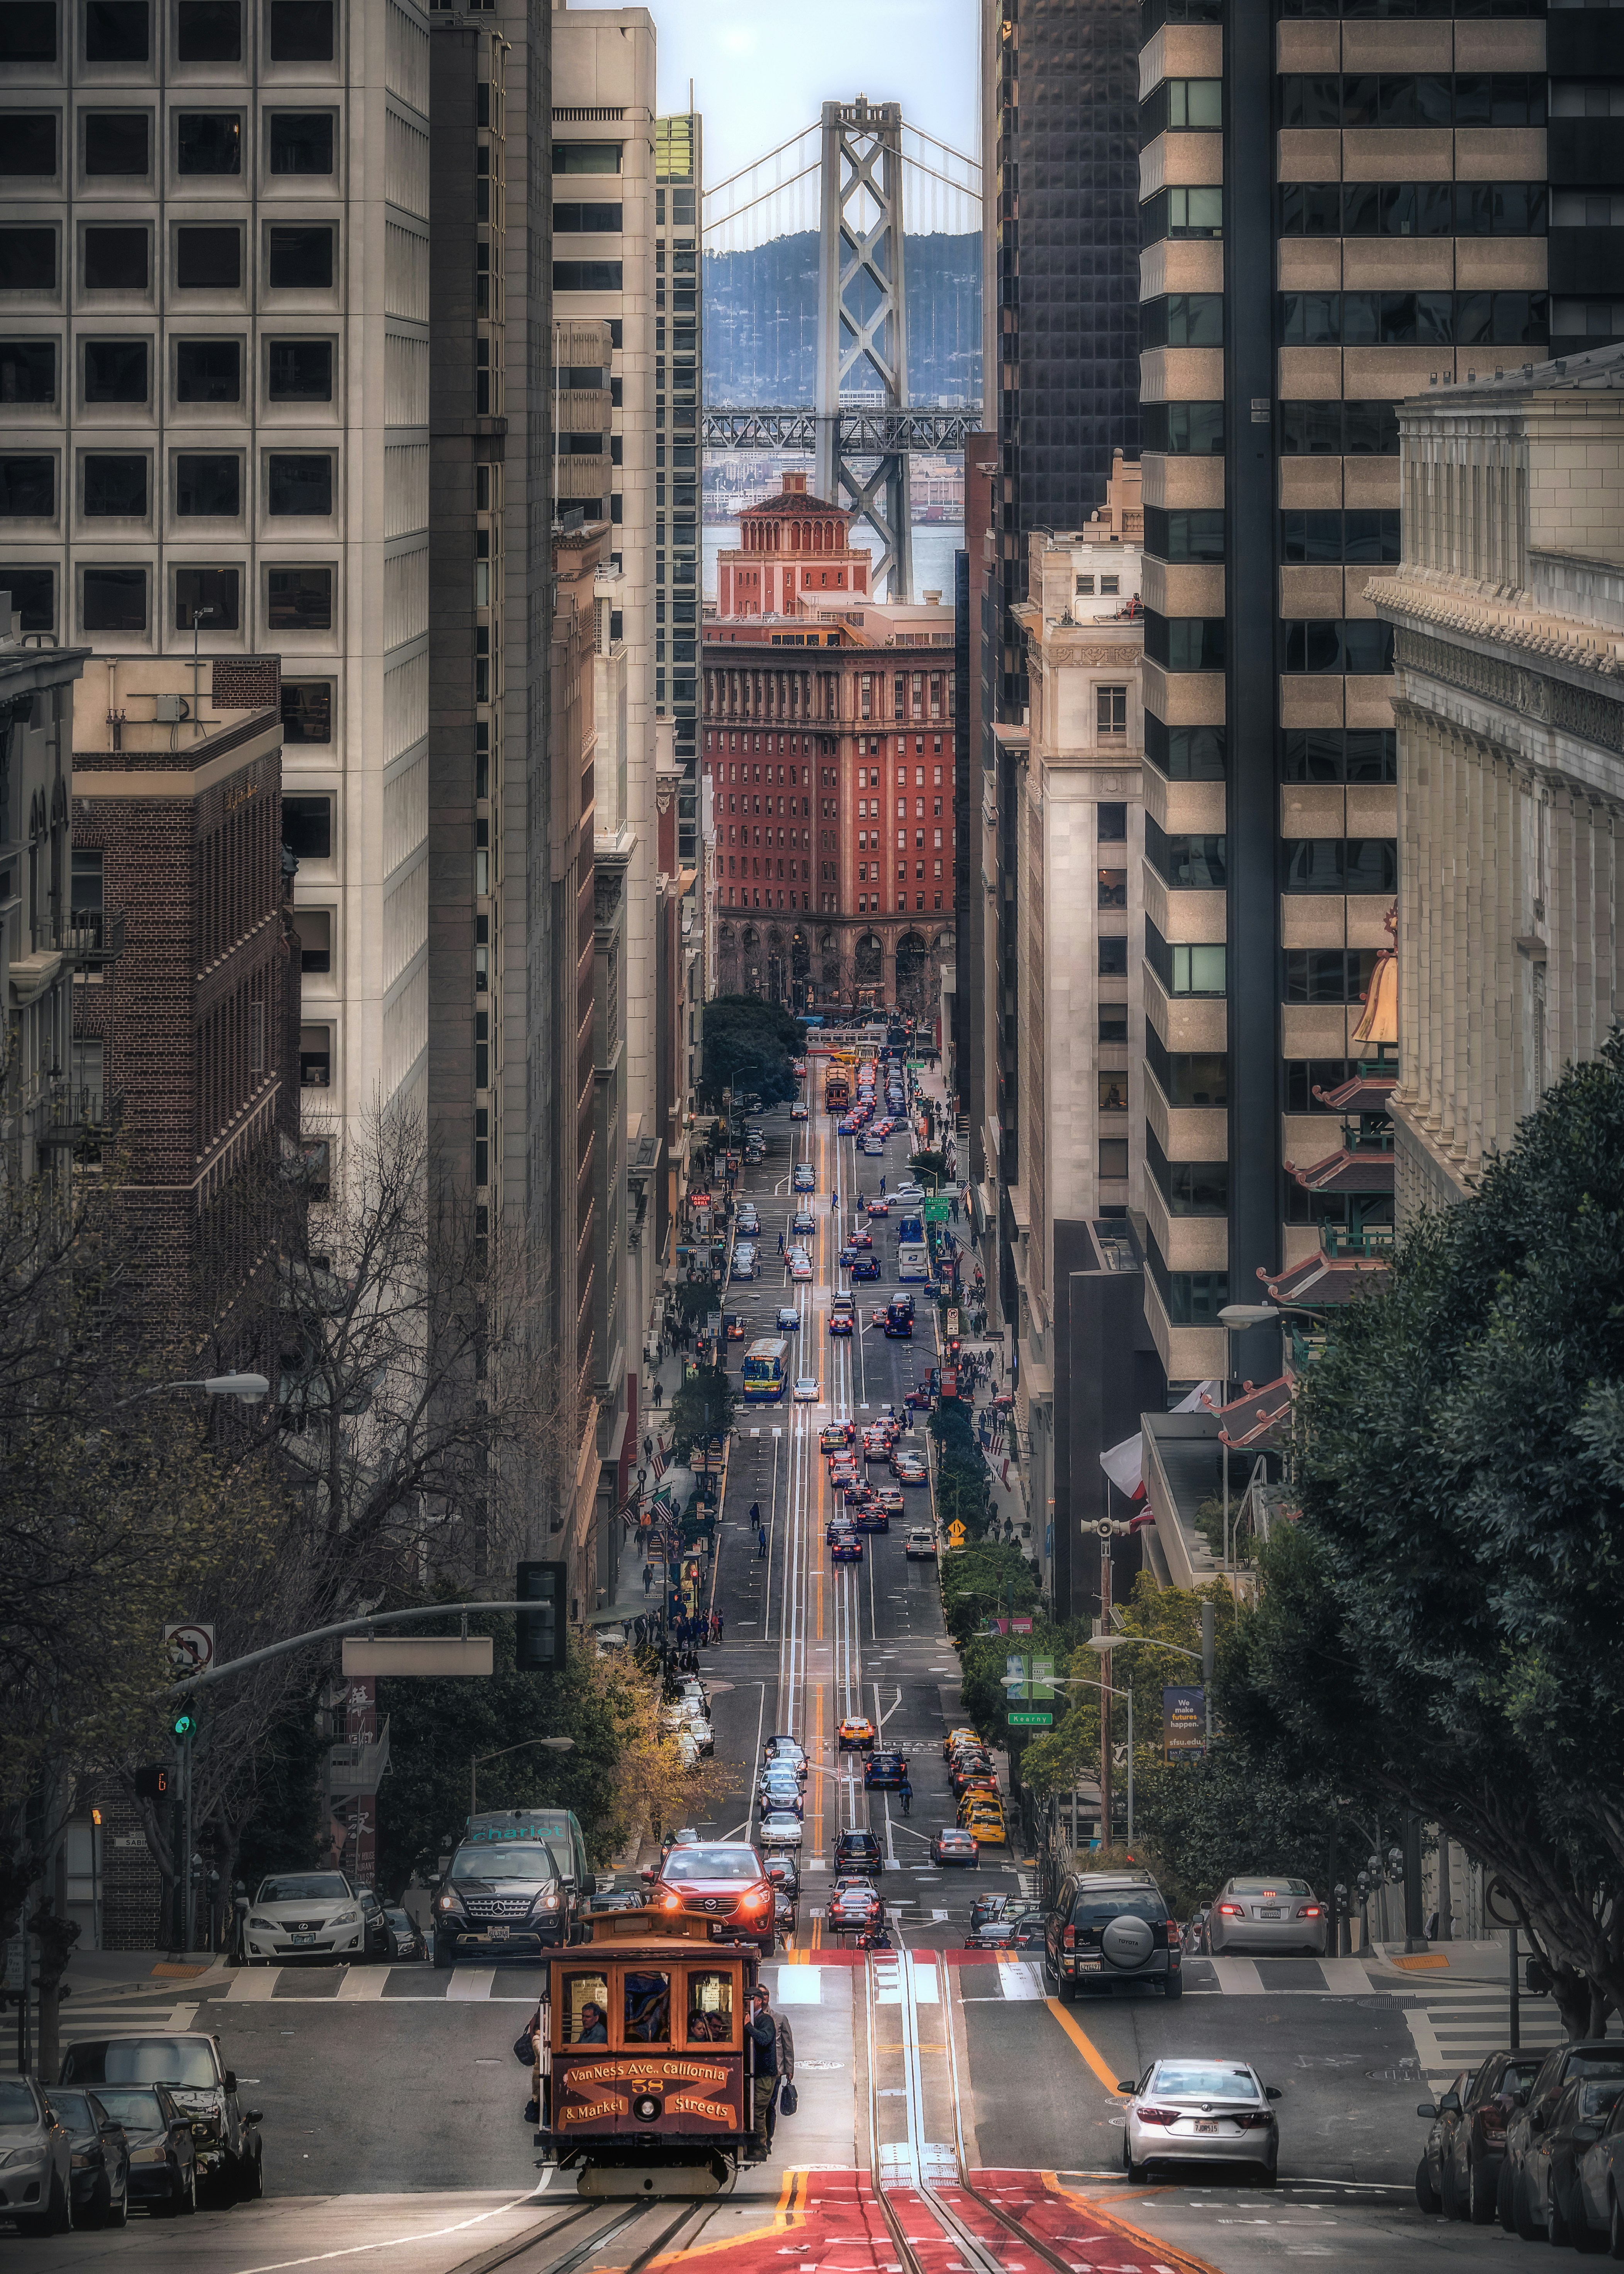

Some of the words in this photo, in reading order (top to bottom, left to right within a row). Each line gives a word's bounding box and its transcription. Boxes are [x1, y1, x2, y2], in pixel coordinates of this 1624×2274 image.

[159, 1773, 166, 1790] 6
[473, 1825, 564, 1840] chariot
[362, 1851, 375, 1860] HOUSE
[571, 2070, 592, 2082] Van
[593, 2066, 624, 2078] Ness
[663, 2063, 725, 2081] California
[632, 2079, 663, 2093] 58
[566, 2107, 575, 2120] &
[578, 2099, 623, 2118] Market
[676, 2098, 728, 2116] Streets
